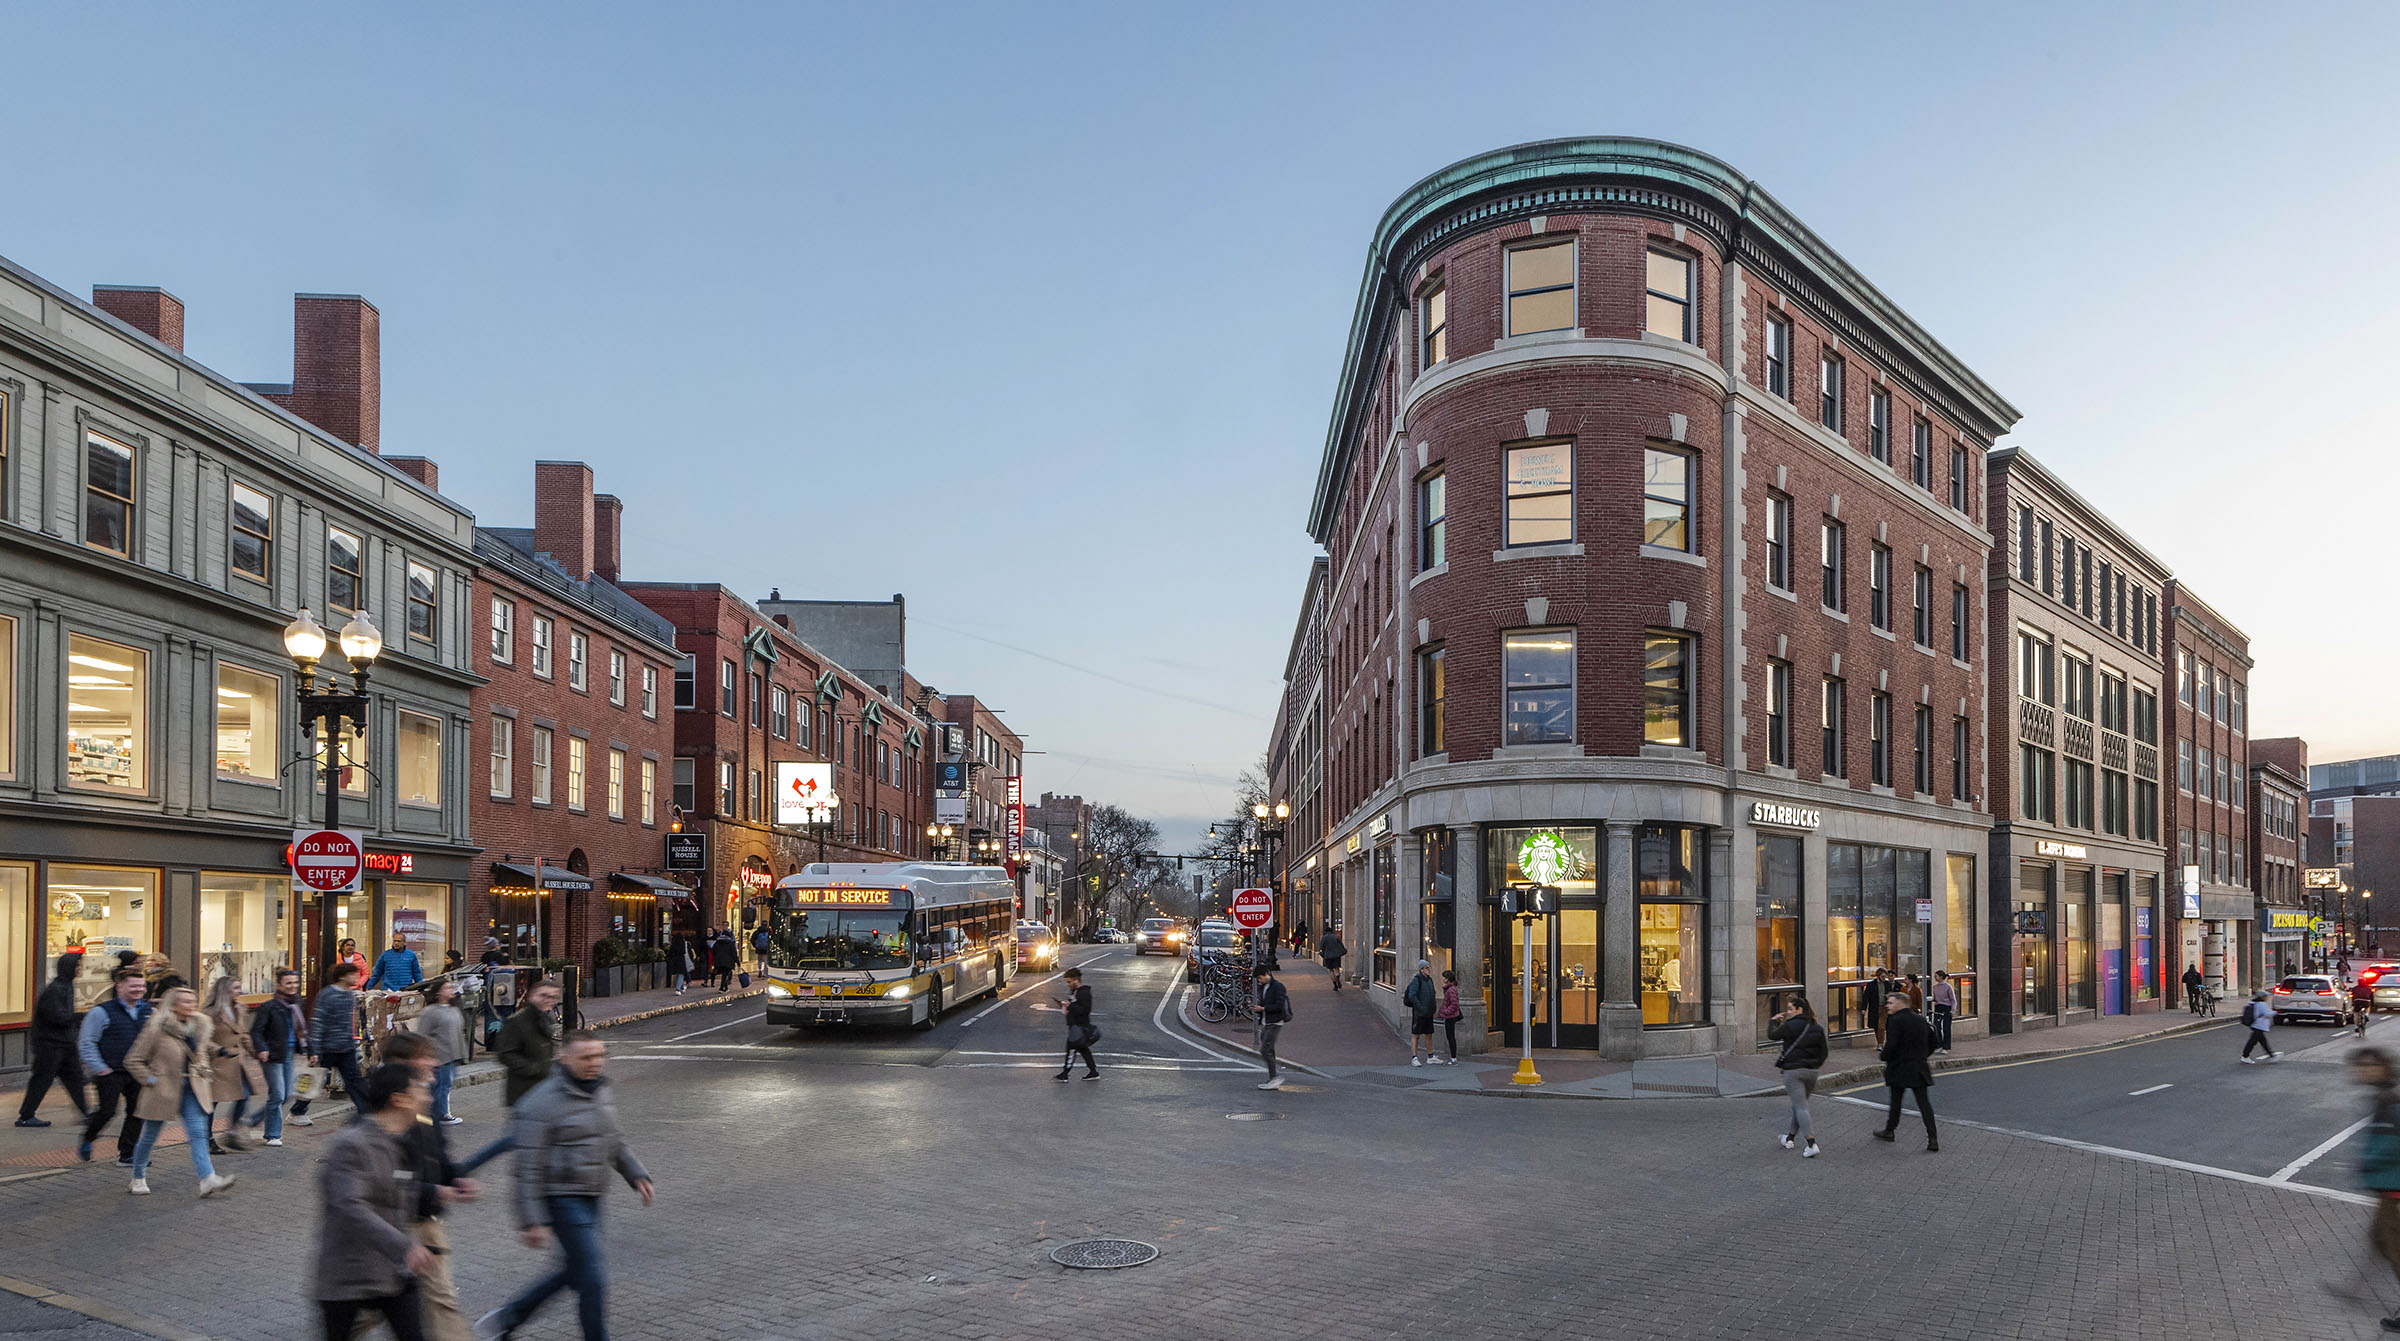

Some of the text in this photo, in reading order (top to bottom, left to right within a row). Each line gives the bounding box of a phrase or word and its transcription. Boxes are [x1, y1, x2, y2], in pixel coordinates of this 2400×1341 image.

[951, 733, 961, 743] 30
[1008, 778, 1020, 805] THE
[1754, 802, 1820, 828] STARBUCKS
[304, 843, 351, 853] DO NOT
[401, 855, 412, 866] 24
[308, 869, 346, 879] ENTER
[750, 869, 772, 888] lovepop
[798, 890, 889, 903] NOT IN SERVICE
[2317, 923, 2326, 932] P
[855, 987, 876, 995] 2093
